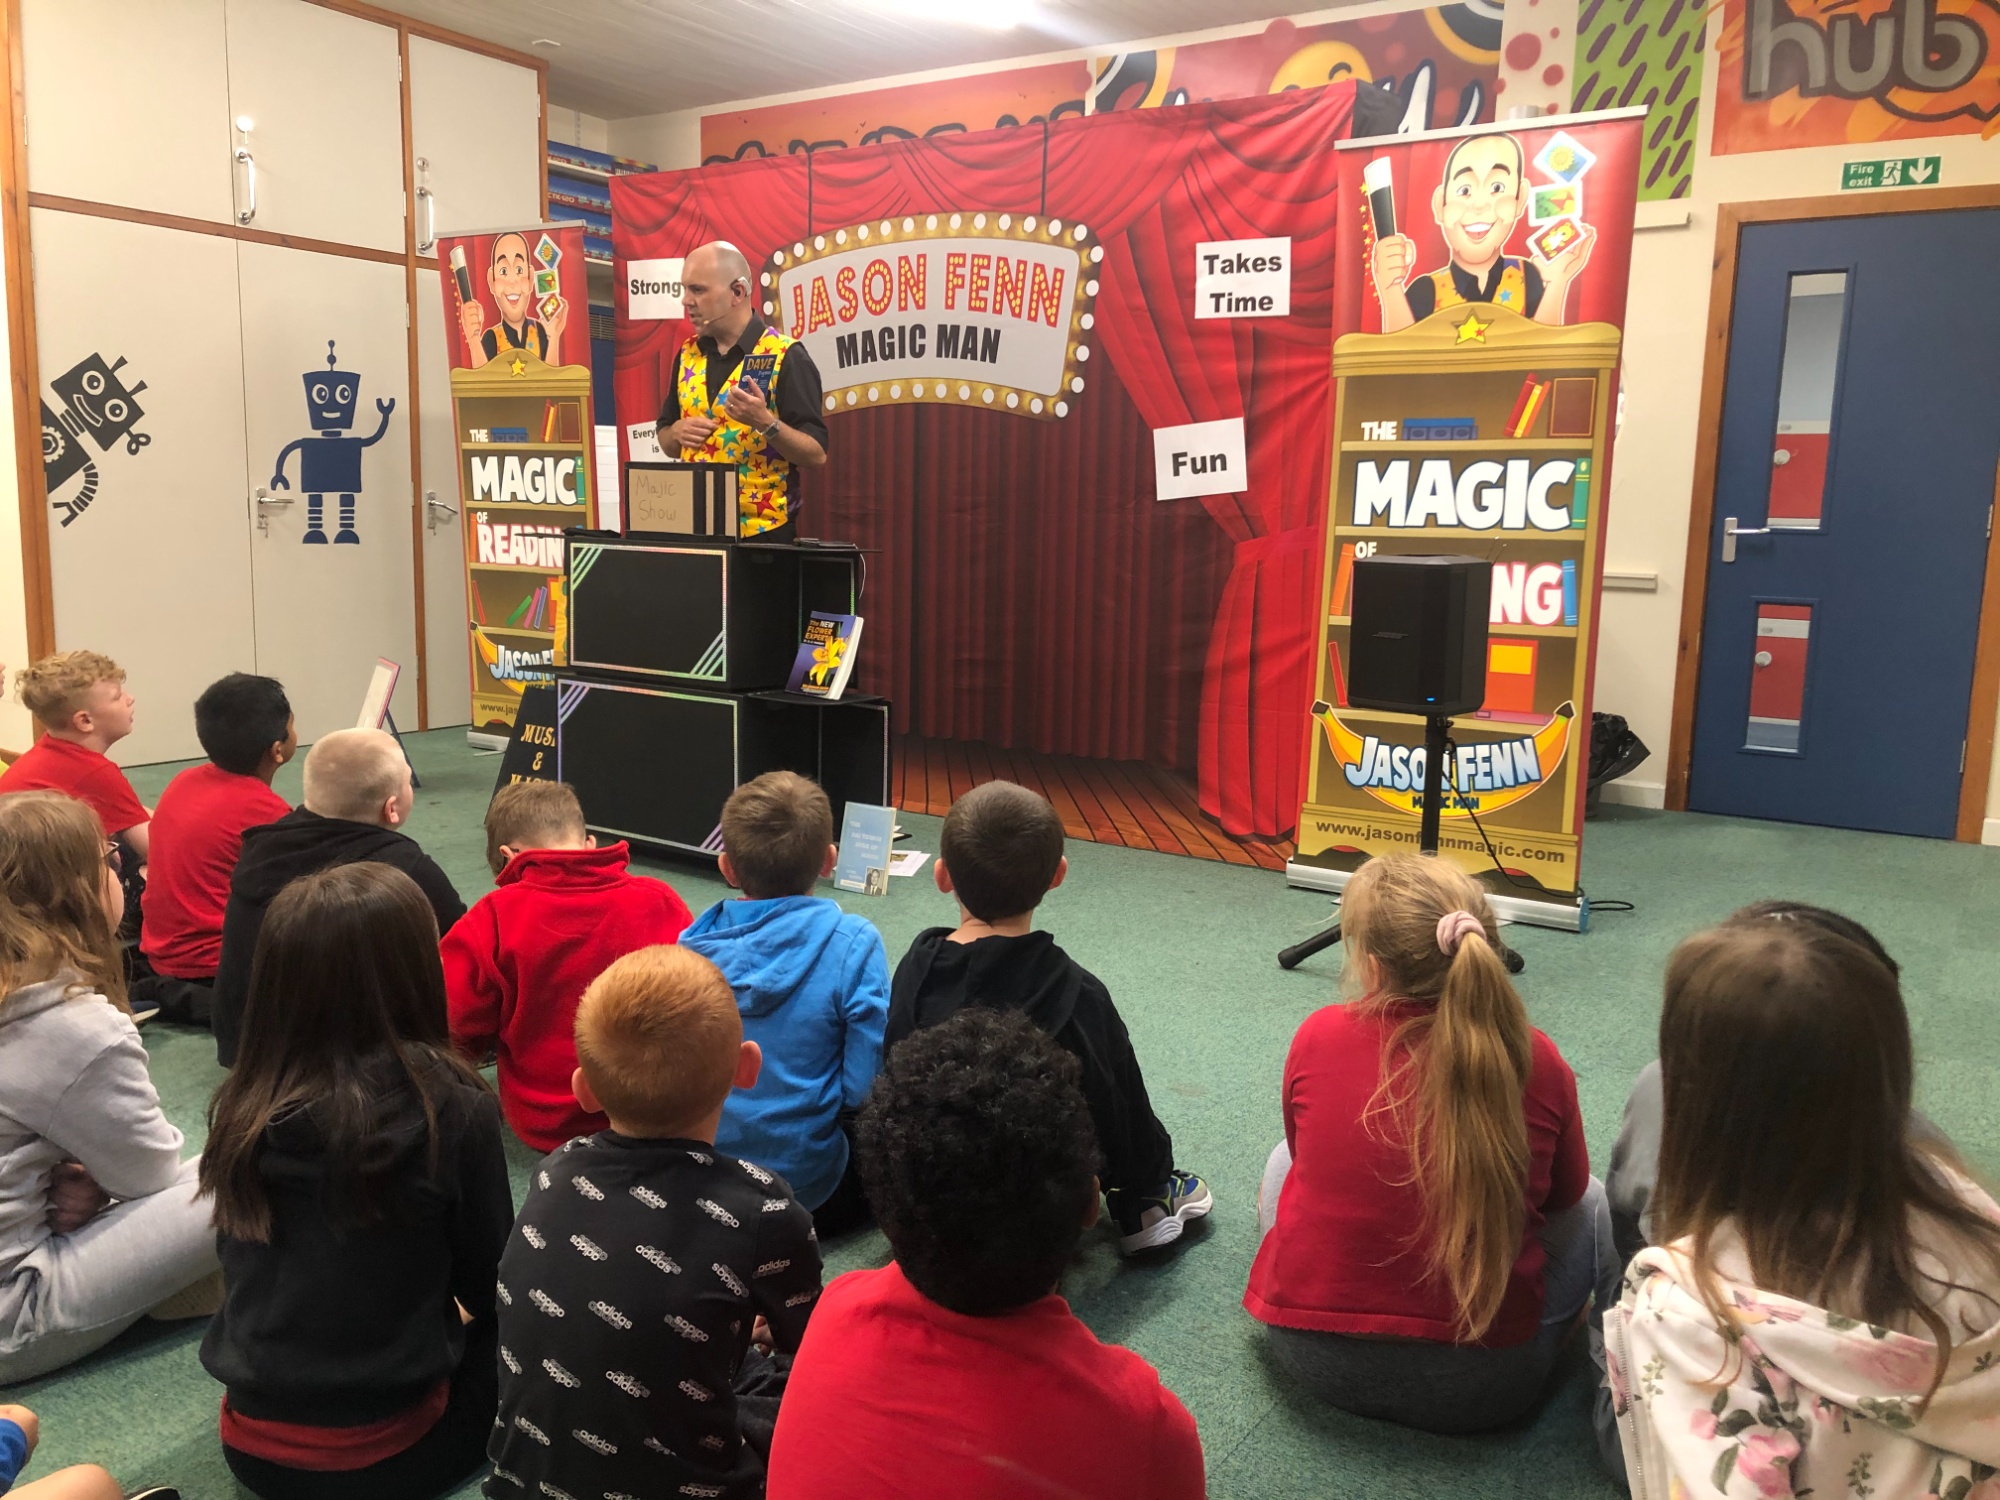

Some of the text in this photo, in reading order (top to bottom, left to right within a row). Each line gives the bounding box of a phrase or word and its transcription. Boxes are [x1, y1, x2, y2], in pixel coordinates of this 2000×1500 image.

[1744, 0, 1985, 97] hub
[1850, 164, 1875, 175] Fire
[1848, 176, 1873, 187] exit
[1203, 253, 1283, 275] Takes
[630, 279, 685, 298] Strong
[791, 253, 1065, 339] JASON FENN
[1209, 292, 1274, 314] Time
[836, 324, 1001, 369] MAGIC MAN
[746, 358, 774, 370] DAVE
[469, 429, 488, 442] THE
[632, 429, 656, 439] Every
[1361, 421, 1397, 441] THE
[652, 445, 659, 453] is
[1172, 452, 1227, 477] Fun
[471, 456, 577, 505] MAGIC
[636, 475, 676, 498] Majic
[1353, 459, 1576, 531] MAGIC
[476, 512, 488, 523] OF
[639, 500, 677, 520] Show
[477, 524, 564, 567] READIN
[1354, 541, 1377, 559] OF
[520, 724, 556, 747] MUS
[532, 752, 544, 771] &
[1456, 735, 1543, 793] FENN
[1453, 797, 1479, 809] MAN
[1316, 821, 1565, 863] www.jasonfnnmagic.com
[637, 1186, 667, 1209] adidas
[635, 1244, 673, 1273] adidas
[758, 1259, 791, 1273] adidas
[597, 1301, 632, 1329] adidas
[606, 1371, 641, 1398] adidas
[580, 1430, 618, 1454] adidas
